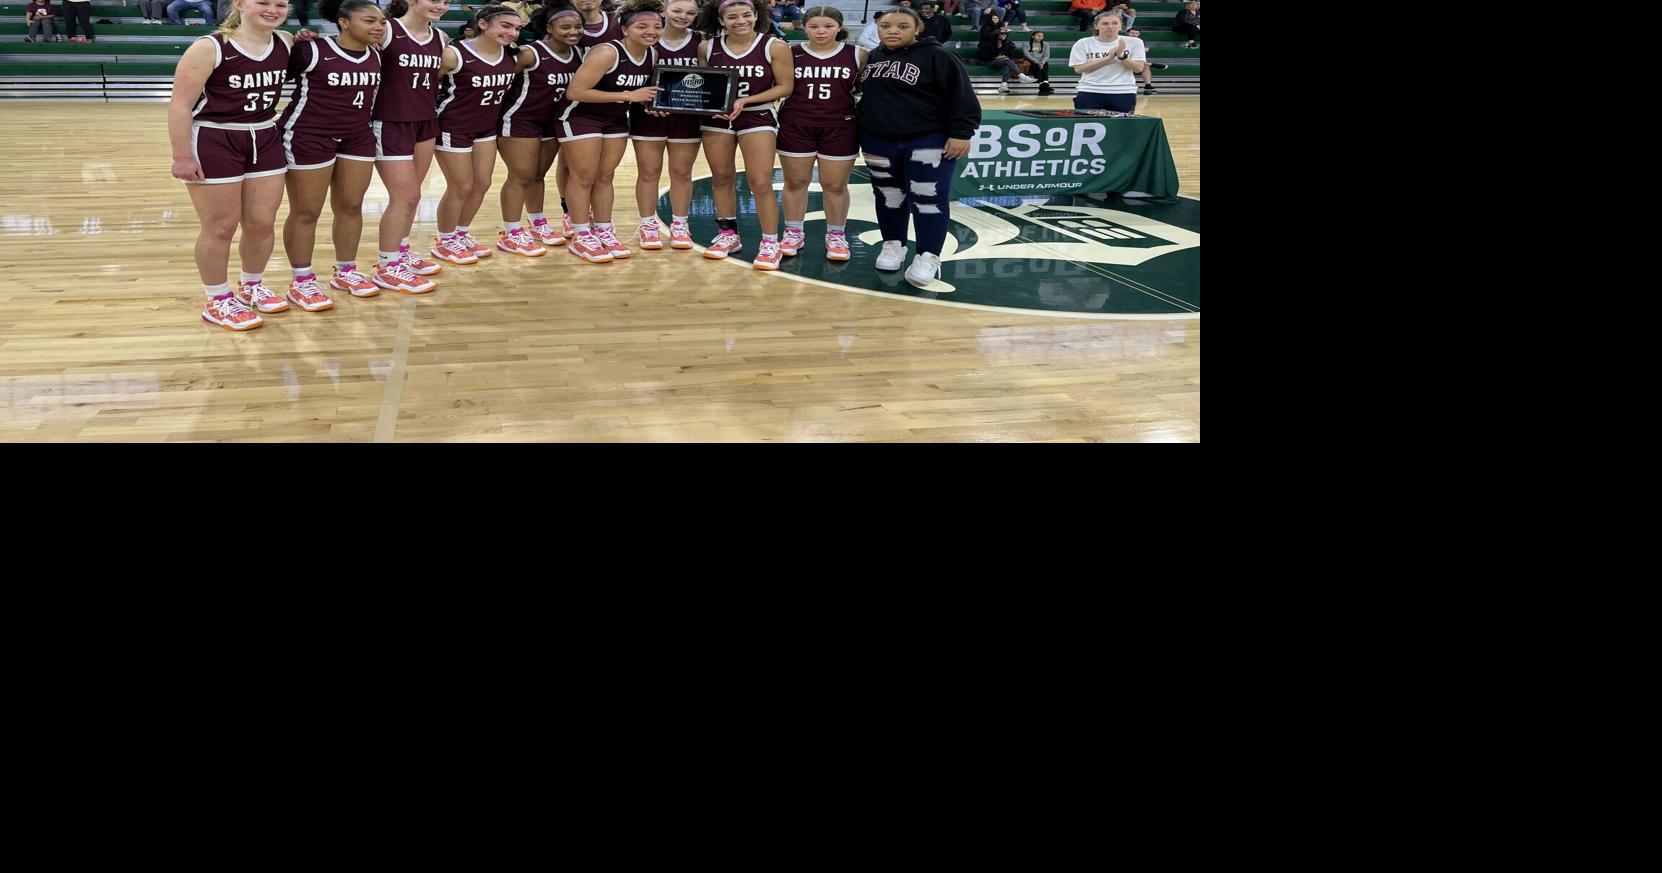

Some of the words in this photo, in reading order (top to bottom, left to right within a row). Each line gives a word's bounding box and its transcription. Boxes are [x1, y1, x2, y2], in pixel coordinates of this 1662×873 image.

[658, 57, 698, 67] AINTS
[228, 69, 287, 89] SAINTS
[327, 71, 381, 86] SAINTS
[714, 65, 765, 78] NTS
[794, 66, 851, 79] SAINTS
[615, 73, 650, 87] SAINT
[352, 90, 365, 109] 4
[479, 89, 505, 106] 23
[553, 87, 566, 102] 3
[806, 83, 831, 100] 15
[243, 91, 276, 112] 35
[960, 158, 1107, 178] ATHLETICS
